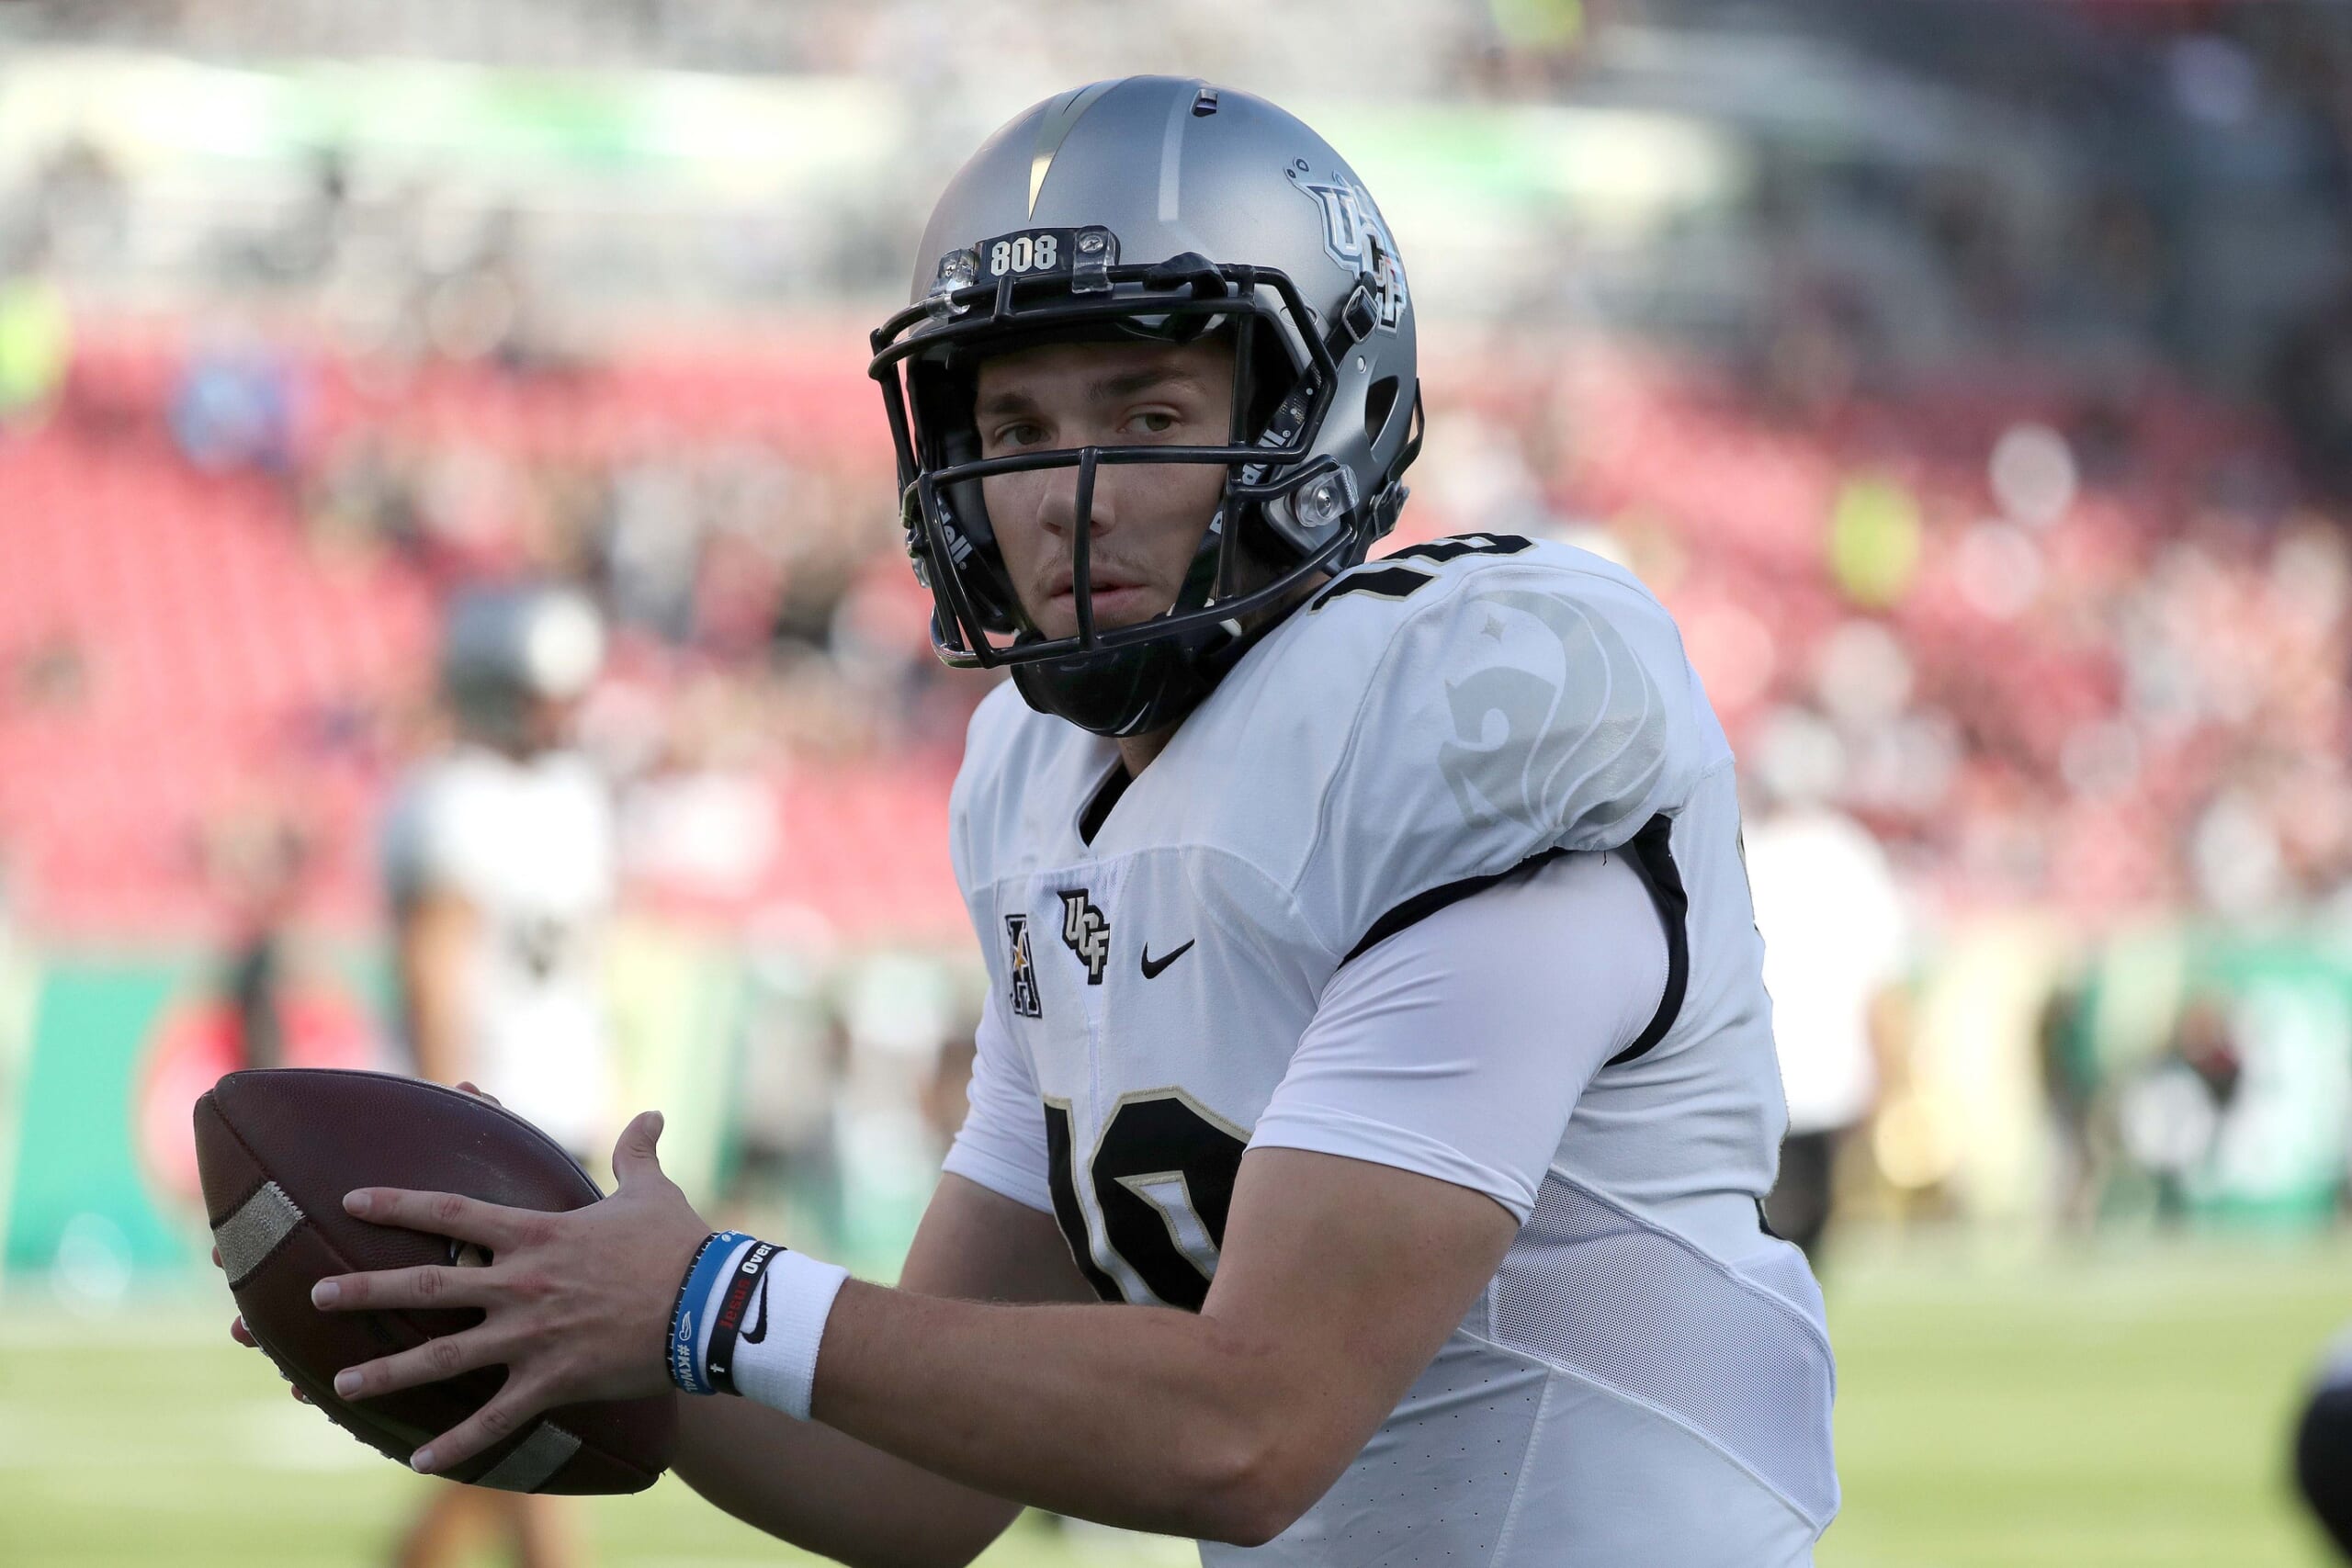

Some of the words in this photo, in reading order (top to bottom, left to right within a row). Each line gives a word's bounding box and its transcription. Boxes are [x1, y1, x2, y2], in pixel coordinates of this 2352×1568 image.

[990, 234, 1057, 276] 808
[1057, 887, 1111, 986] UCF
[741, 1244, 773, 1275] Over
